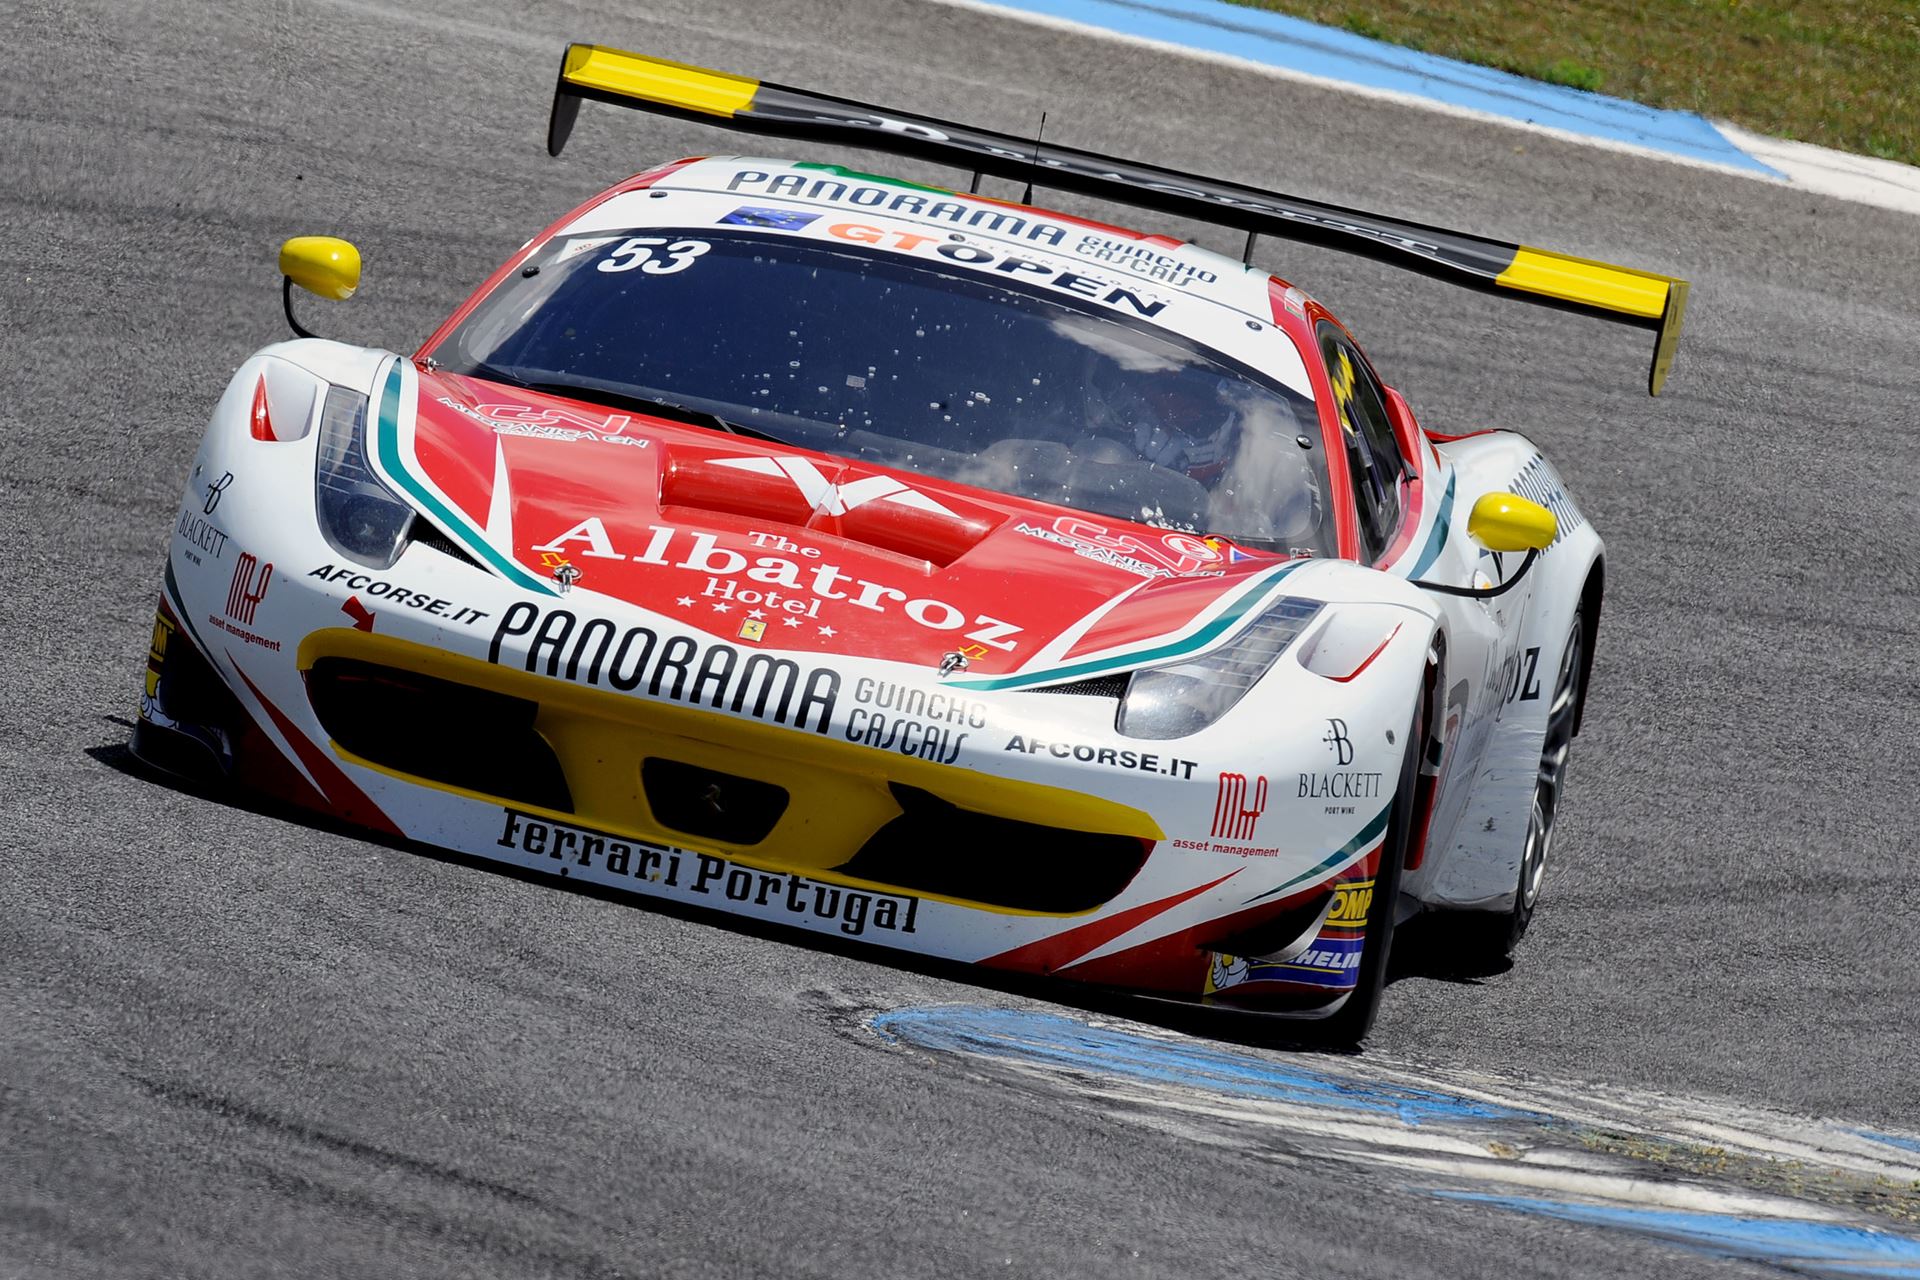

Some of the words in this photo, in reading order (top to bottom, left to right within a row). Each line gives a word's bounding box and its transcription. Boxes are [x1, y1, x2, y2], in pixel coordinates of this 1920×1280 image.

[726, 170, 1067, 247] PANORAMA
[597, 237, 711, 275] 53
[827, 222, 939, 251] GT
[936, 243, 1168, 318] OPEN
[966, 240, 1174, 305] NTERNATIONAL
[1075, 243, 1197, 287] CASCAIS
[1082, 235, 1218, 284] GUINCHO
[179, 509, 229, 559] BLACKETT
[748, 531, 822, 559] The
[308, 565, 490, 627] AFCORSE.IT
[532, 516, 1024, 652] Albatroz
[700, 577, 822, 619] Hotel
[208, 614, 225, 630] asset
[226, 623, 281, 653] management
[488, 601, 842, 735] PANORAMA
[854, 677, 987, 729] GUINCHO
[845, 708, 968, 765] CASCAIS
[1004, 735, 1198, 781] AFCORSE.IT
[1297, 772, 1383, 798] BLACKETT
[496, 806, 682, 887] Ferrari
[690, 852, 920, 936] Portugal
[1172, 839, 1210, 852] asset
[1211, 844, 1280, 858] management
